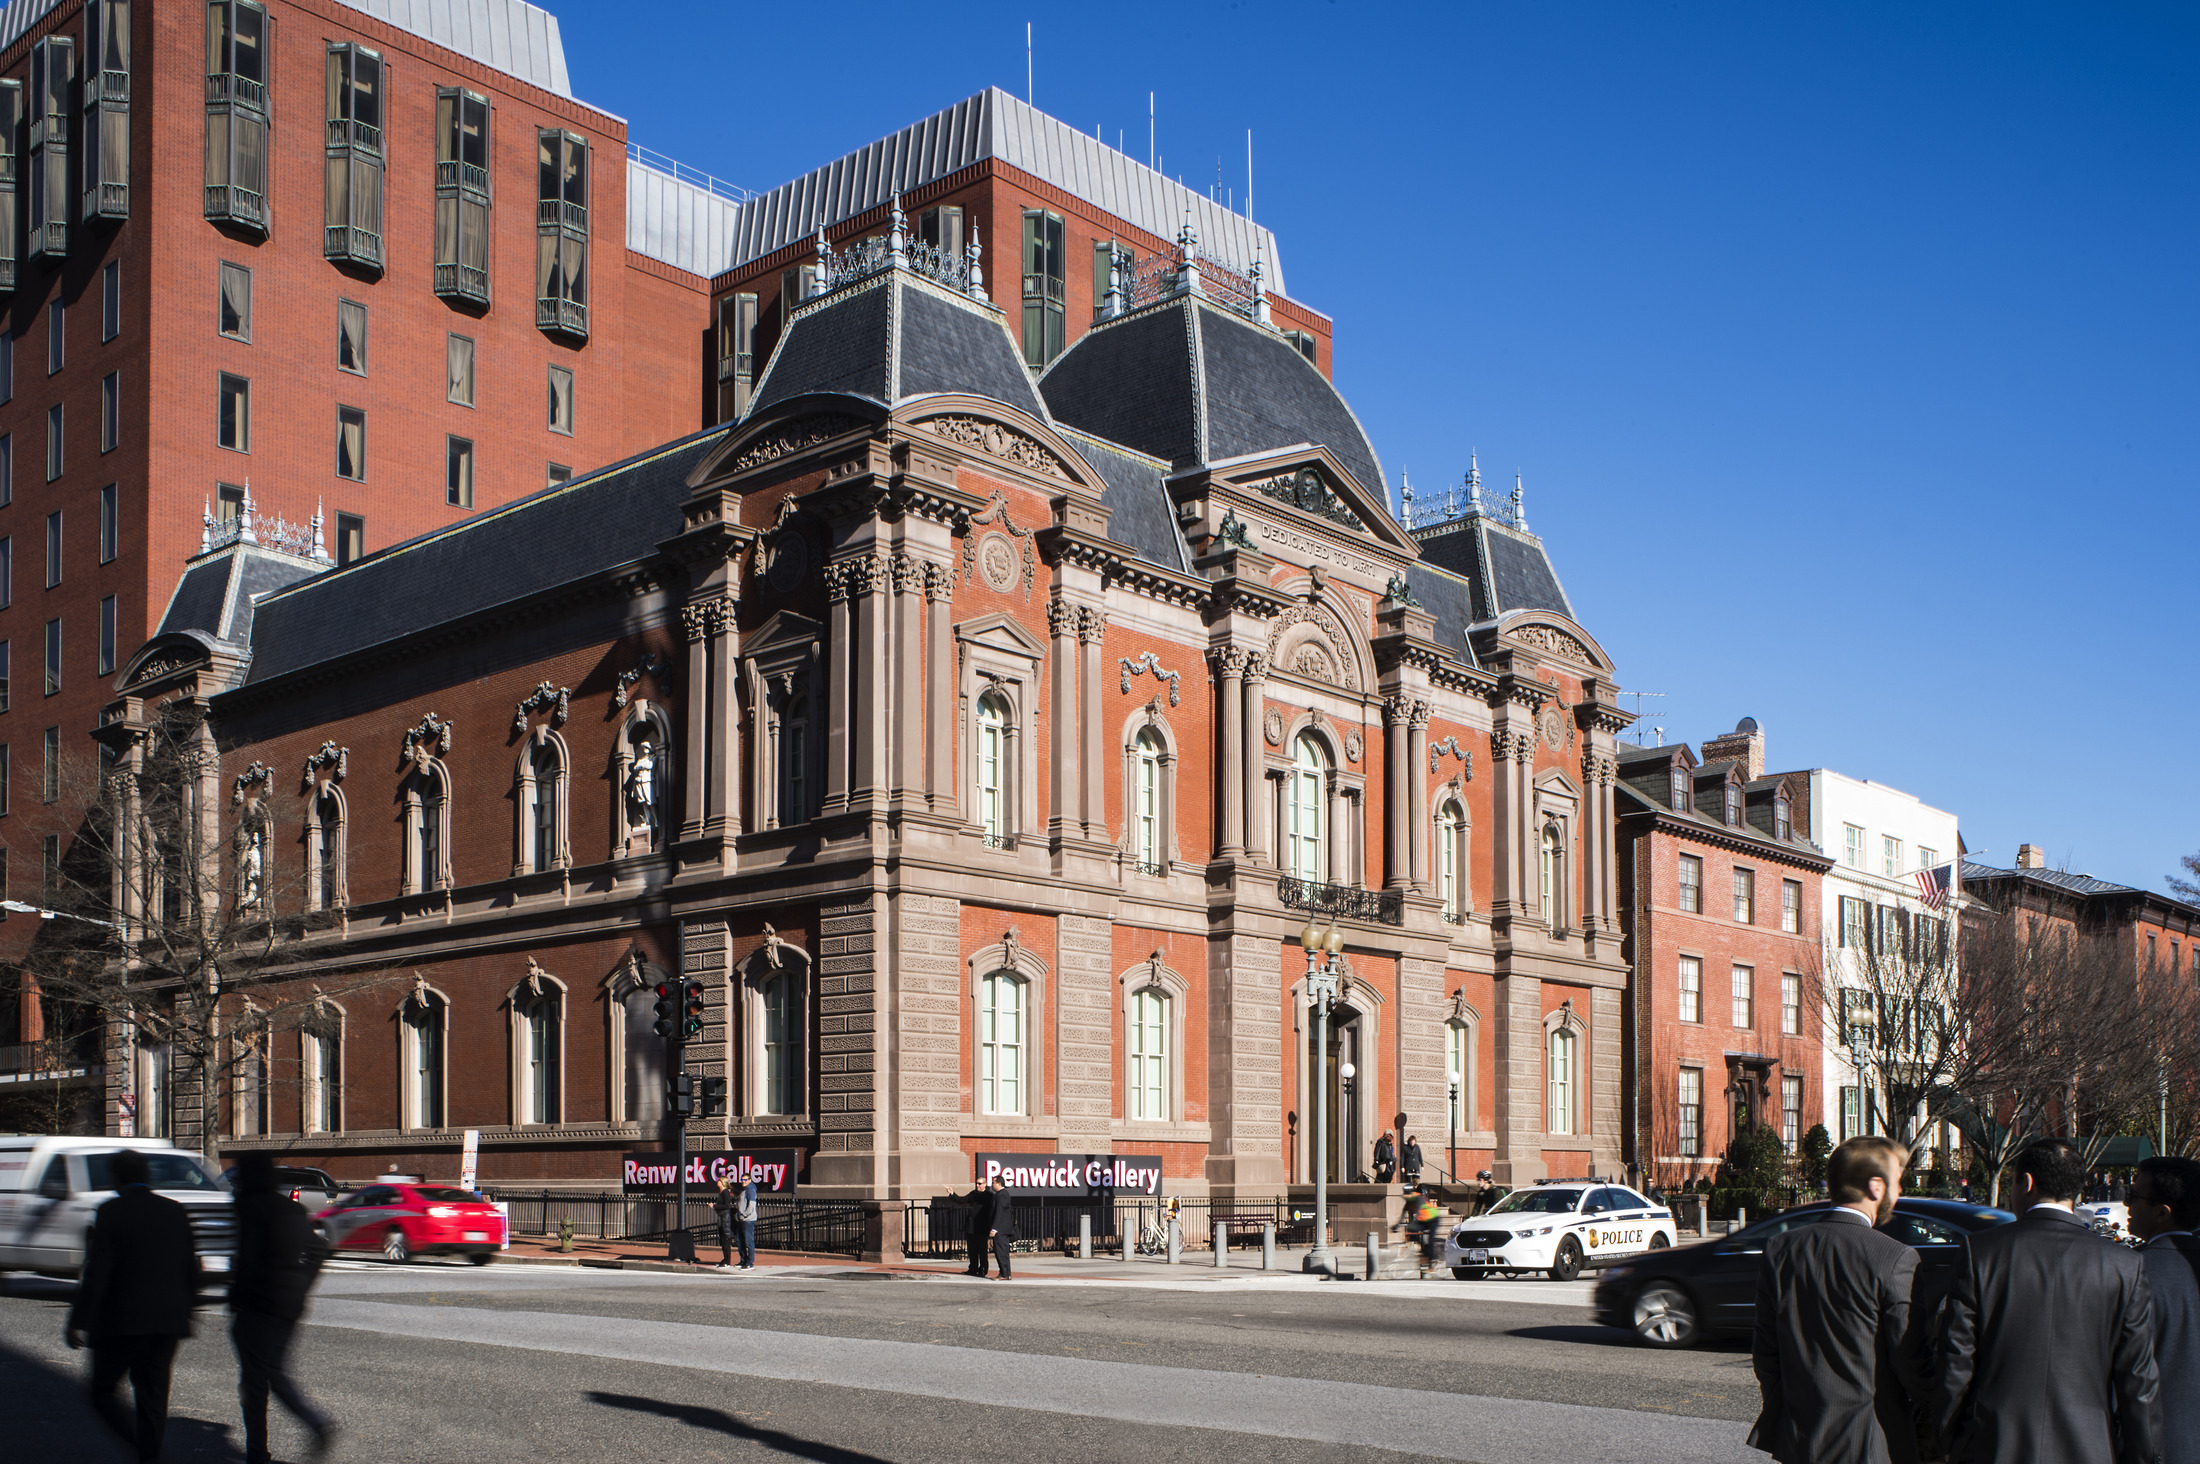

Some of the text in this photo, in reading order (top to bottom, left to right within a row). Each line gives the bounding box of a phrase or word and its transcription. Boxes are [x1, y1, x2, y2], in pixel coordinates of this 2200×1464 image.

[1262, 524, 1329, 559] DEDICATED
[1334, 551, 1348, 567] TO
[624, 1155, 787, 1191] Renwck Gallery
[1084, 1160, 1160, 1195] Gallery
[1601, 1229, 1643, 1246] POLICE
